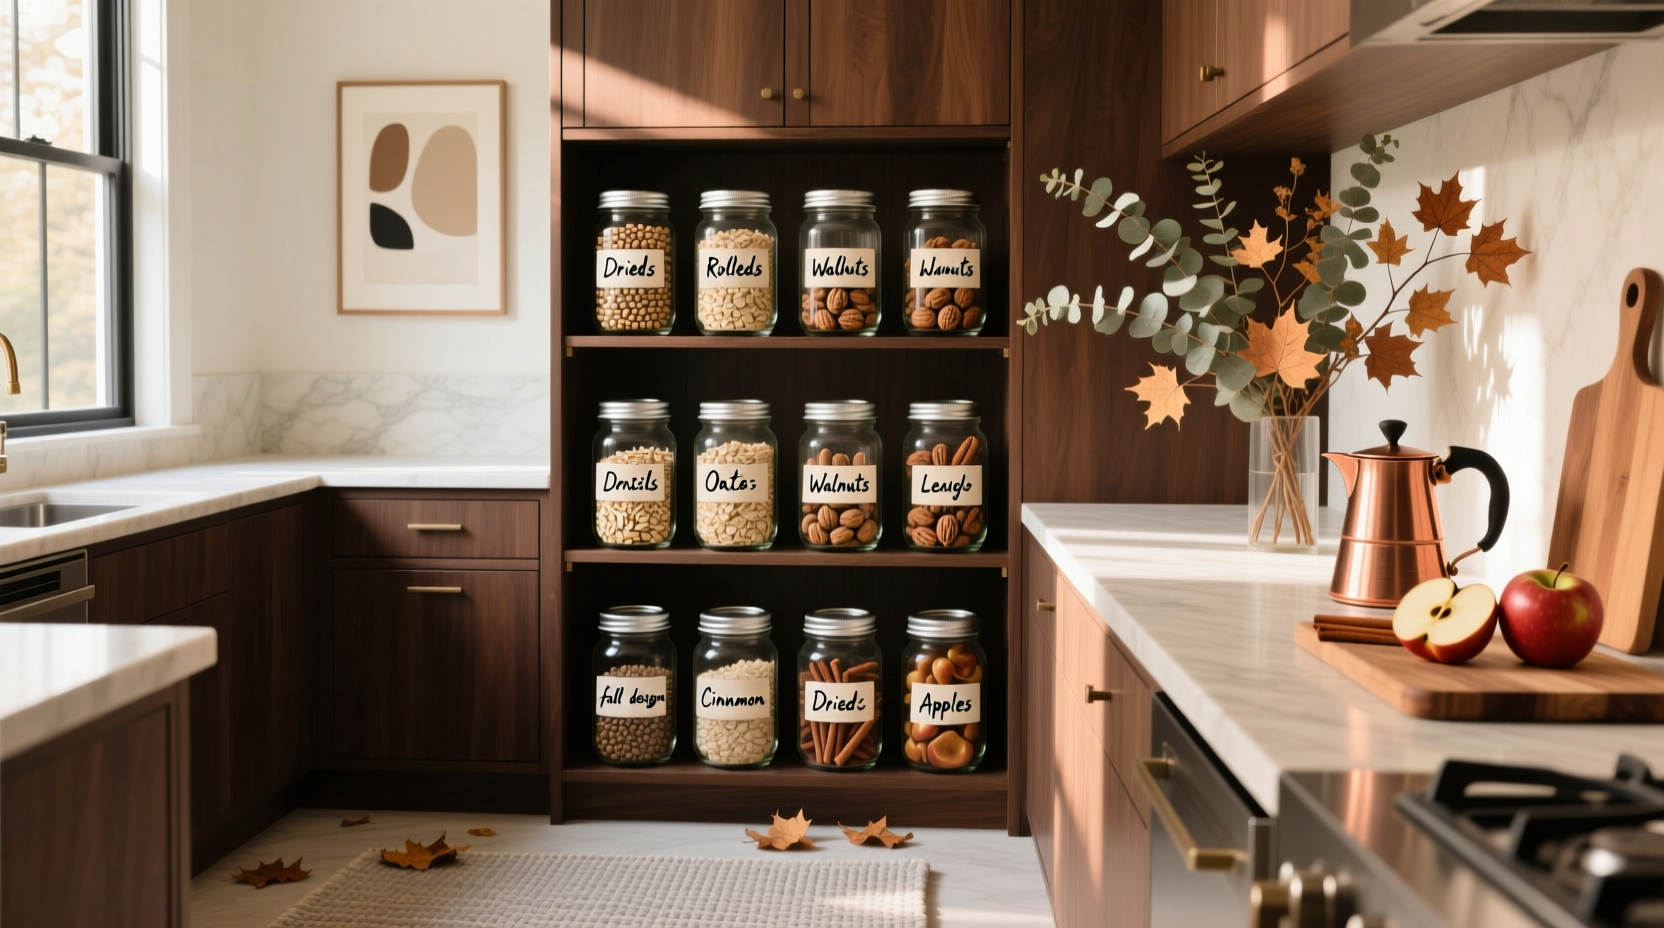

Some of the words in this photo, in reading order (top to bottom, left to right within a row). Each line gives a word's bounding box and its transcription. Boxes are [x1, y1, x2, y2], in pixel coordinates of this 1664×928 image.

[604, 255, 655, 278] Drieds
[707, 255, 762, 278] Rolleds
[810, 473, 869, 493] Walnuts
[919, 692, 972, 721] Apples
